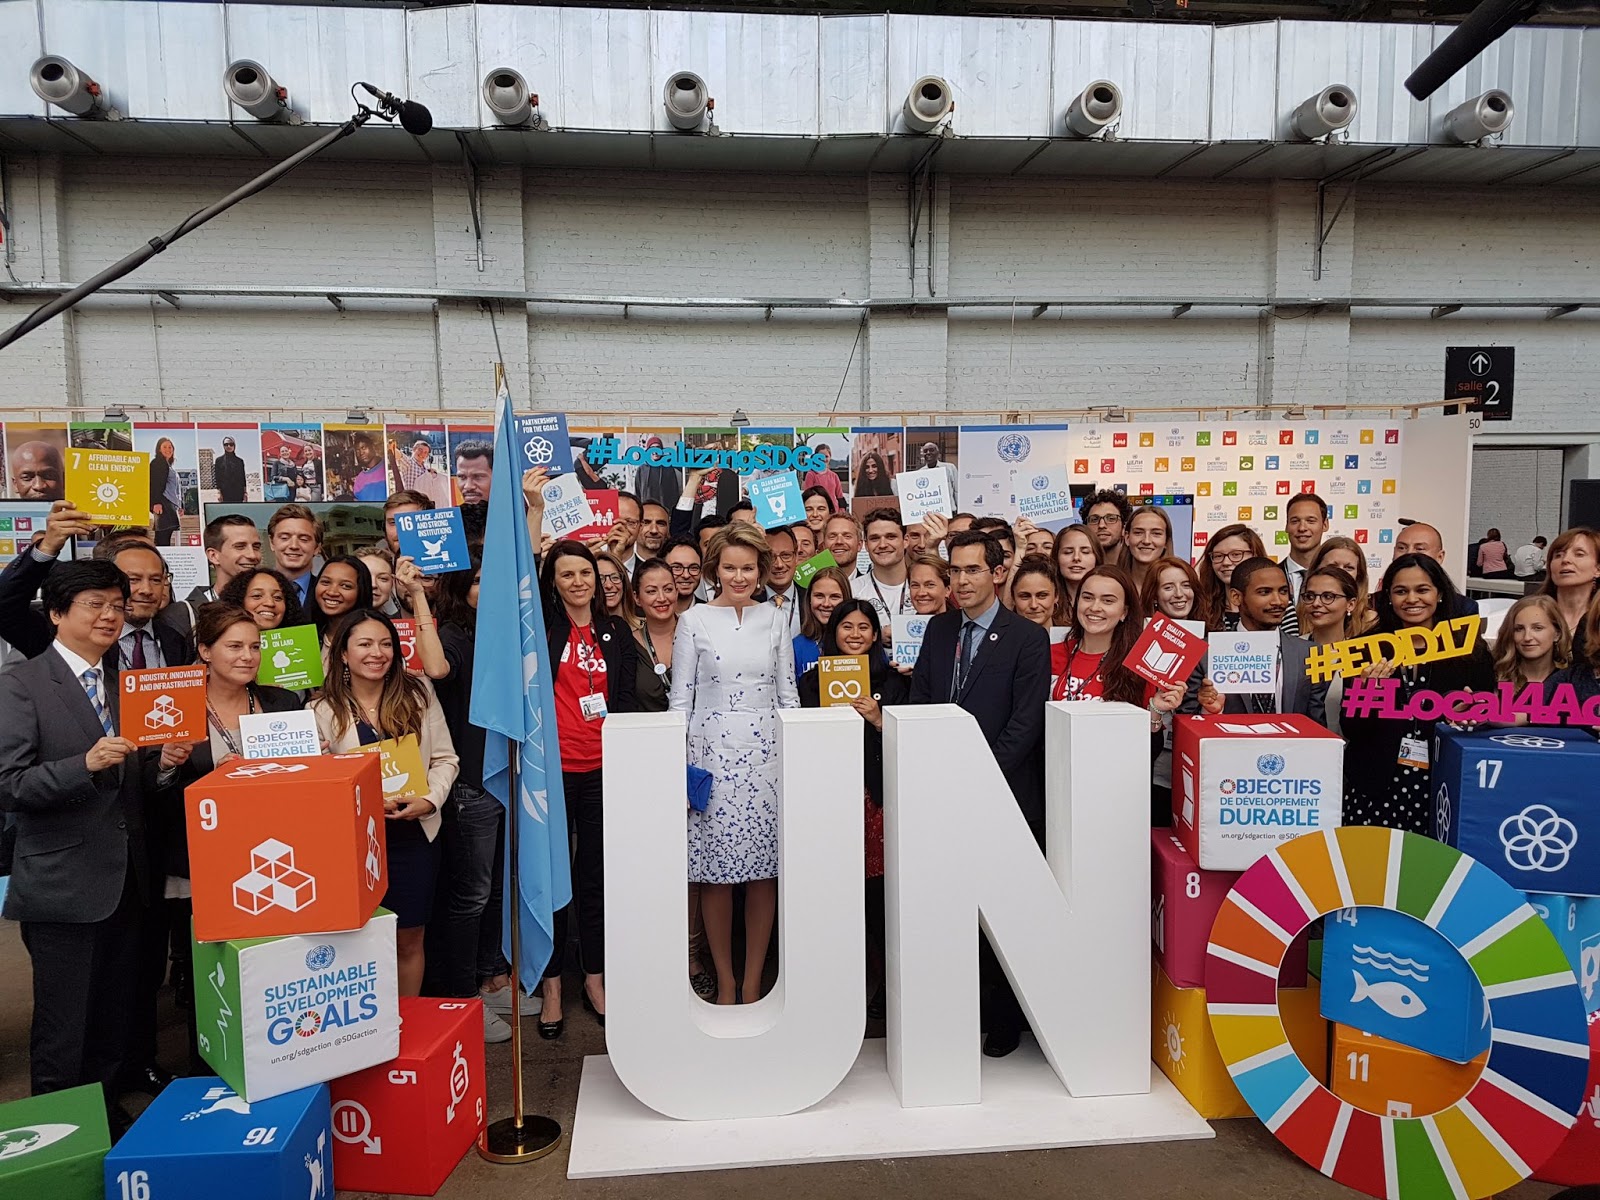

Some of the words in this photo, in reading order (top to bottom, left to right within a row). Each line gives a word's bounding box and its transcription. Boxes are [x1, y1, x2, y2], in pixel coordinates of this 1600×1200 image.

[1458, 380, 1483, 391] salle
[1484, 380, 1500, 405] 2
[521, 416, 558, 427] PARTNERSHIPS
[523, 426, 533, 434] FOR
[533, 425, 542, 433] THE
[542, 423, 559, 432] GOALS
[1469, 418, 1480, 429] 50
[72, 453, 81, 470] 7
[88, 453, 127, 464] AFFORDABLE
[127, 456, 141, 464] AND
[586, 437, 827, 475] #LocalizingSDGs
[88, 463, 109, 472] CLEAN
[110, 464, 135, 473] ENERGY
[752, 484, 759, 495] 6
[915, 485, 942, 499] أهداف
[1019, 496, 1040, 506] ZIELE
[1042, 492, 1057, 502] FÜR
[1020, 498, 1068, 512] NACHHALTIGE
[1021, 505, 1069, 519] ENTWICKLUNG
[398, 516, 413, 532] 16
[433, 510, 454, 520] JUSTICE
[416, 521, 427, 529] AND
[427, 519, 449, 529] STRONG
[551, 509, 582, 532] 目标
[417, 527, 453, 537] INSTITUTIONS
[794, 570, 802, 580] 3
[1153, 618, 1165, 632] 4
[1166, 623, 1186, 639] QUALITY
[282, 638, 294, 646] LAND
[896, 644, 920, 655] ACT
[1305, 614, 1481, 684] #EDD17
[577, 657, 607, 673] 203
[821, 659, 831, 672] 12
[896, 655, 917, 664] CAM
[1212, 654, 1272, 663] SUSTAINABLE
[1212, 663, 1271, 671] DEVELOPMENT
[125, 675, 136, 693] 9
[139, 672, 169, 683] INDUSTRY,
[169, 669, 204, 680] INNOVATION
[1213, 670, 1271, 684] GOALS
[139, 683, 152, 692] AND
[152, 679, 204, 691] INFRASTRUCTURE
[247, 730, 314, 743] OBJECTIFS
[248, 744, 316, 759] DURABLE
[1476, 759, 1503, 789] 17
[1220, 778, 1321, 795] OBJECTIFS
[1220, 797, 1234, 806] DE
[1235, 795, 1320, 807] DÉVELOPPEMENT
[199, 798, 218, 831] 9
[1219, 808, 1320, 827] DURABLE
[1221, 832, 1276, 841] un.org/sdgaction
[1185, 872, 1201, 899] 8
[602, 701, 1151, 1121] UN
[1336, 907, 1358, 927] 14
[1567, 902, 1576, 931] 6
[264, 960, 377, 1003] SUSTAINABLE
[265, 978, 377, 1020] DEVELOPMENT
[267, 993, 378, 1046] GOALS
[200, 1033, 210, 1052] 3
[271, 1041, 332, 1064] un.org/sdgaction
[334, 1028, 378, 1046] @SDGaction
[1346, 1051, 1370, 1083] 11
[388, 1069, 417, 1085] 5
[242, 1127, 278, 1146] 16
[117, 1170, 150, 1200] 16
